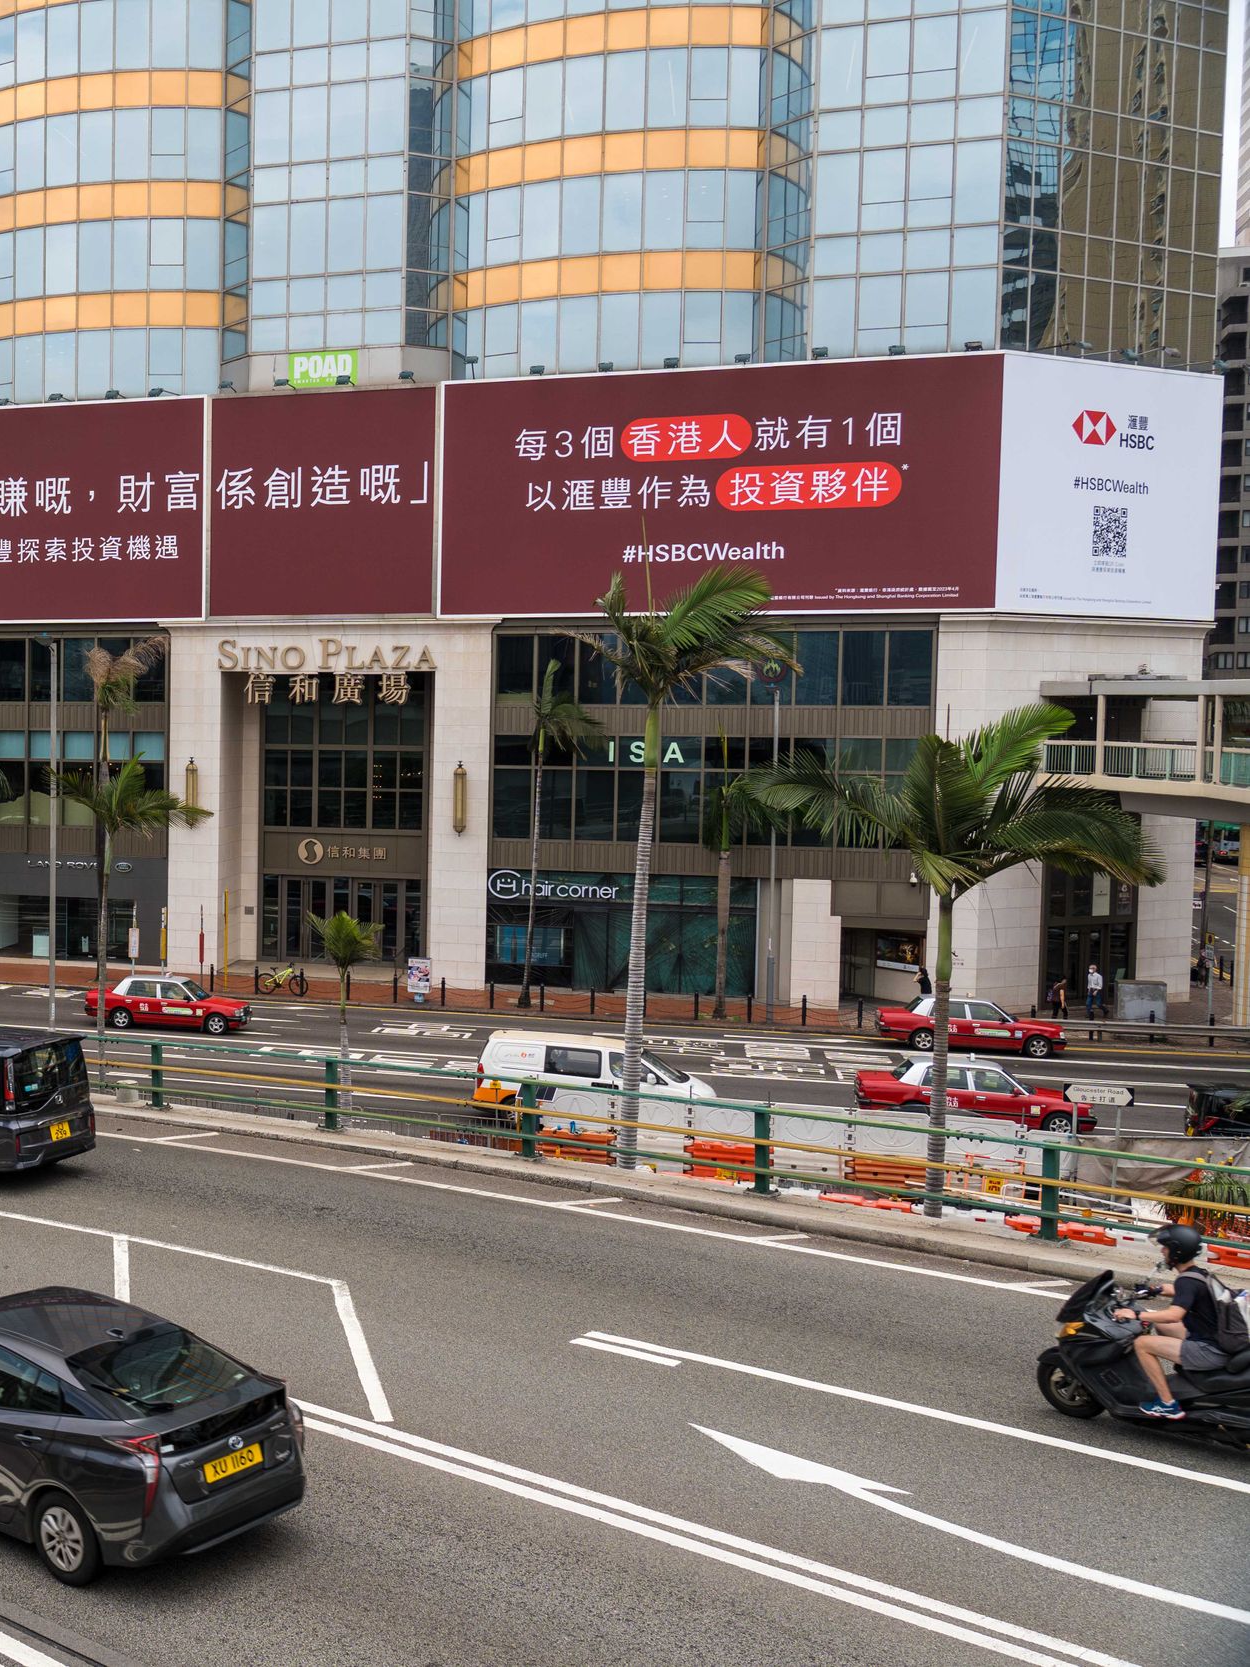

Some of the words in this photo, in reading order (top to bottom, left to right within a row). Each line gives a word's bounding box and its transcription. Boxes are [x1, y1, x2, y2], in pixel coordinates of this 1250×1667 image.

[293, 354, 352, 379] POAD
[515, 411, 903, 461] 每3個香港人就有1個
[1119, 433, 1155, 450] HSBC
[1073, 476, 1149, 495] #HSBCWealth
[622, 541, 785, 563] #HSBCWealth
[218, 638, 306, 670] SINO
[318, 637, 438, 670] PLAZA
[243, 672, 412, 705] 信和廣場
[327, 845, 387, 861] 信和集團
[66, 862, 98, 870] ROVE
[522, 880, 554, 896] hair
[556, 884, 619, 899] corner
[210, 1460, 227, 1477] XU
[232, 1450, 254, 1468] 1160
